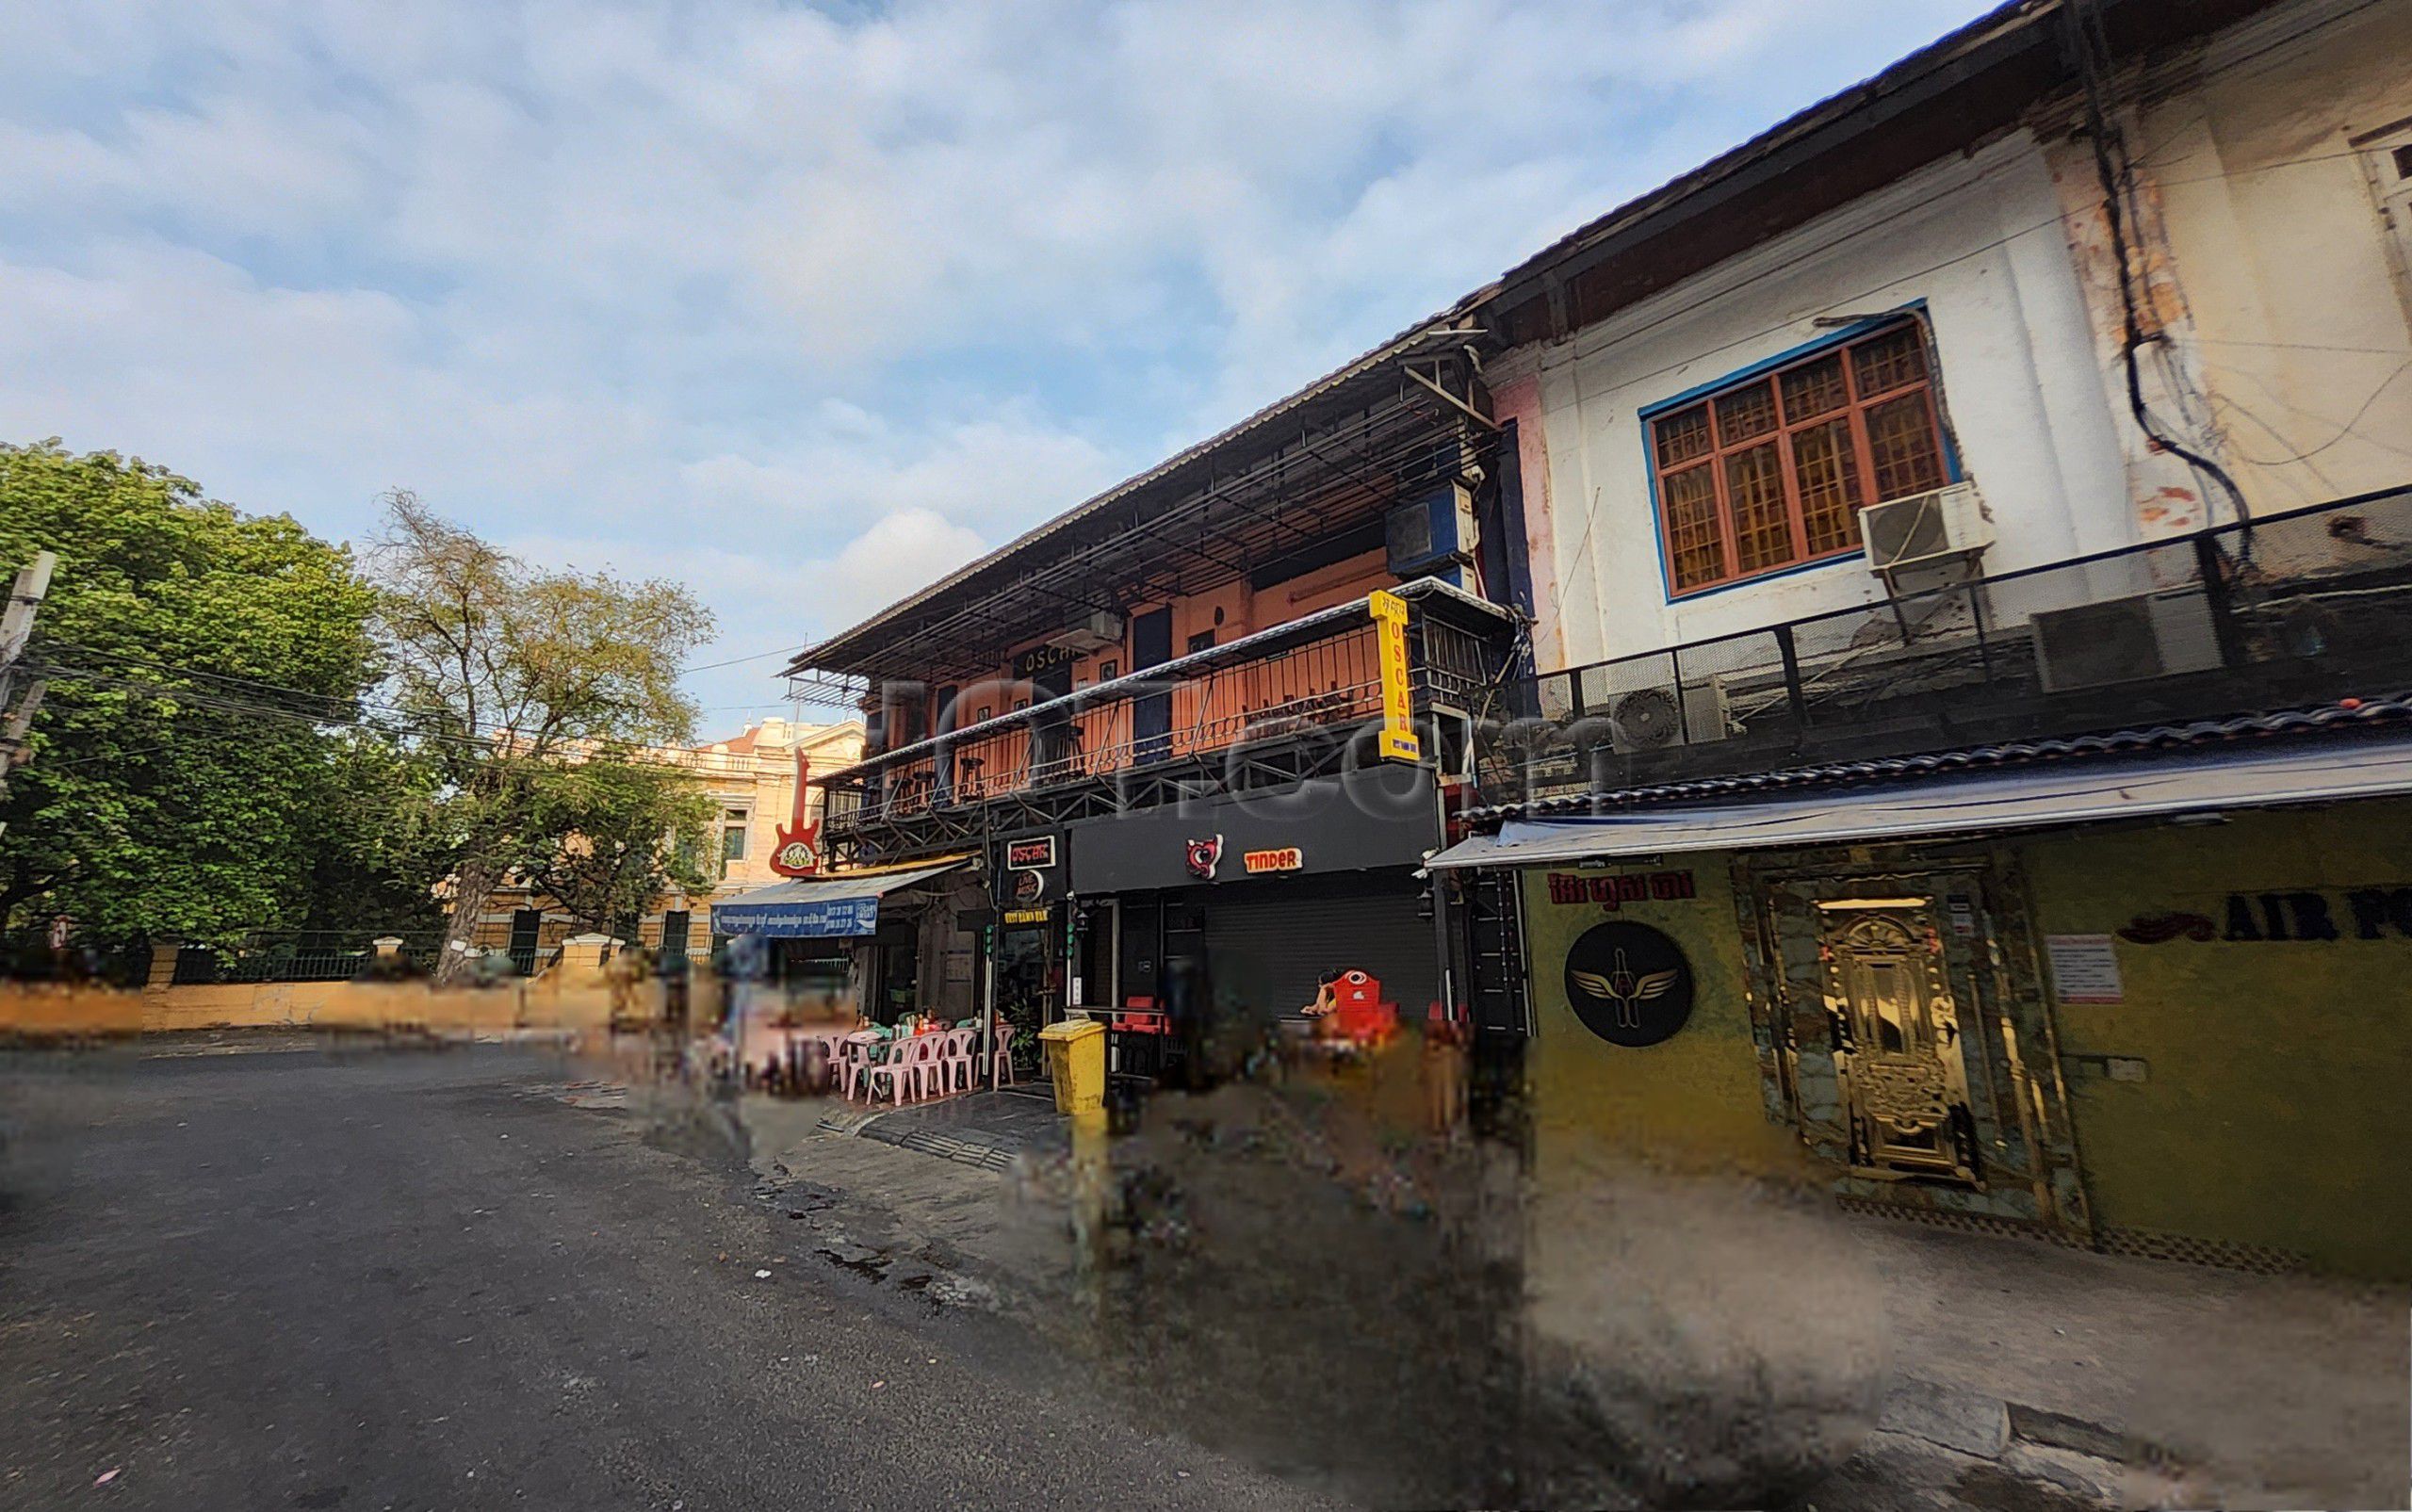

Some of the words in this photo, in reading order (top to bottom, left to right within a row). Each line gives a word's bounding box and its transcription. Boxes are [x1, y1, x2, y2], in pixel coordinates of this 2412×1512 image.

[1392, 622, 1408, 732] OSCAR
[1012, 844, 1049, 862] OSCAR
[2223, 891, 2340, 941] AIR
